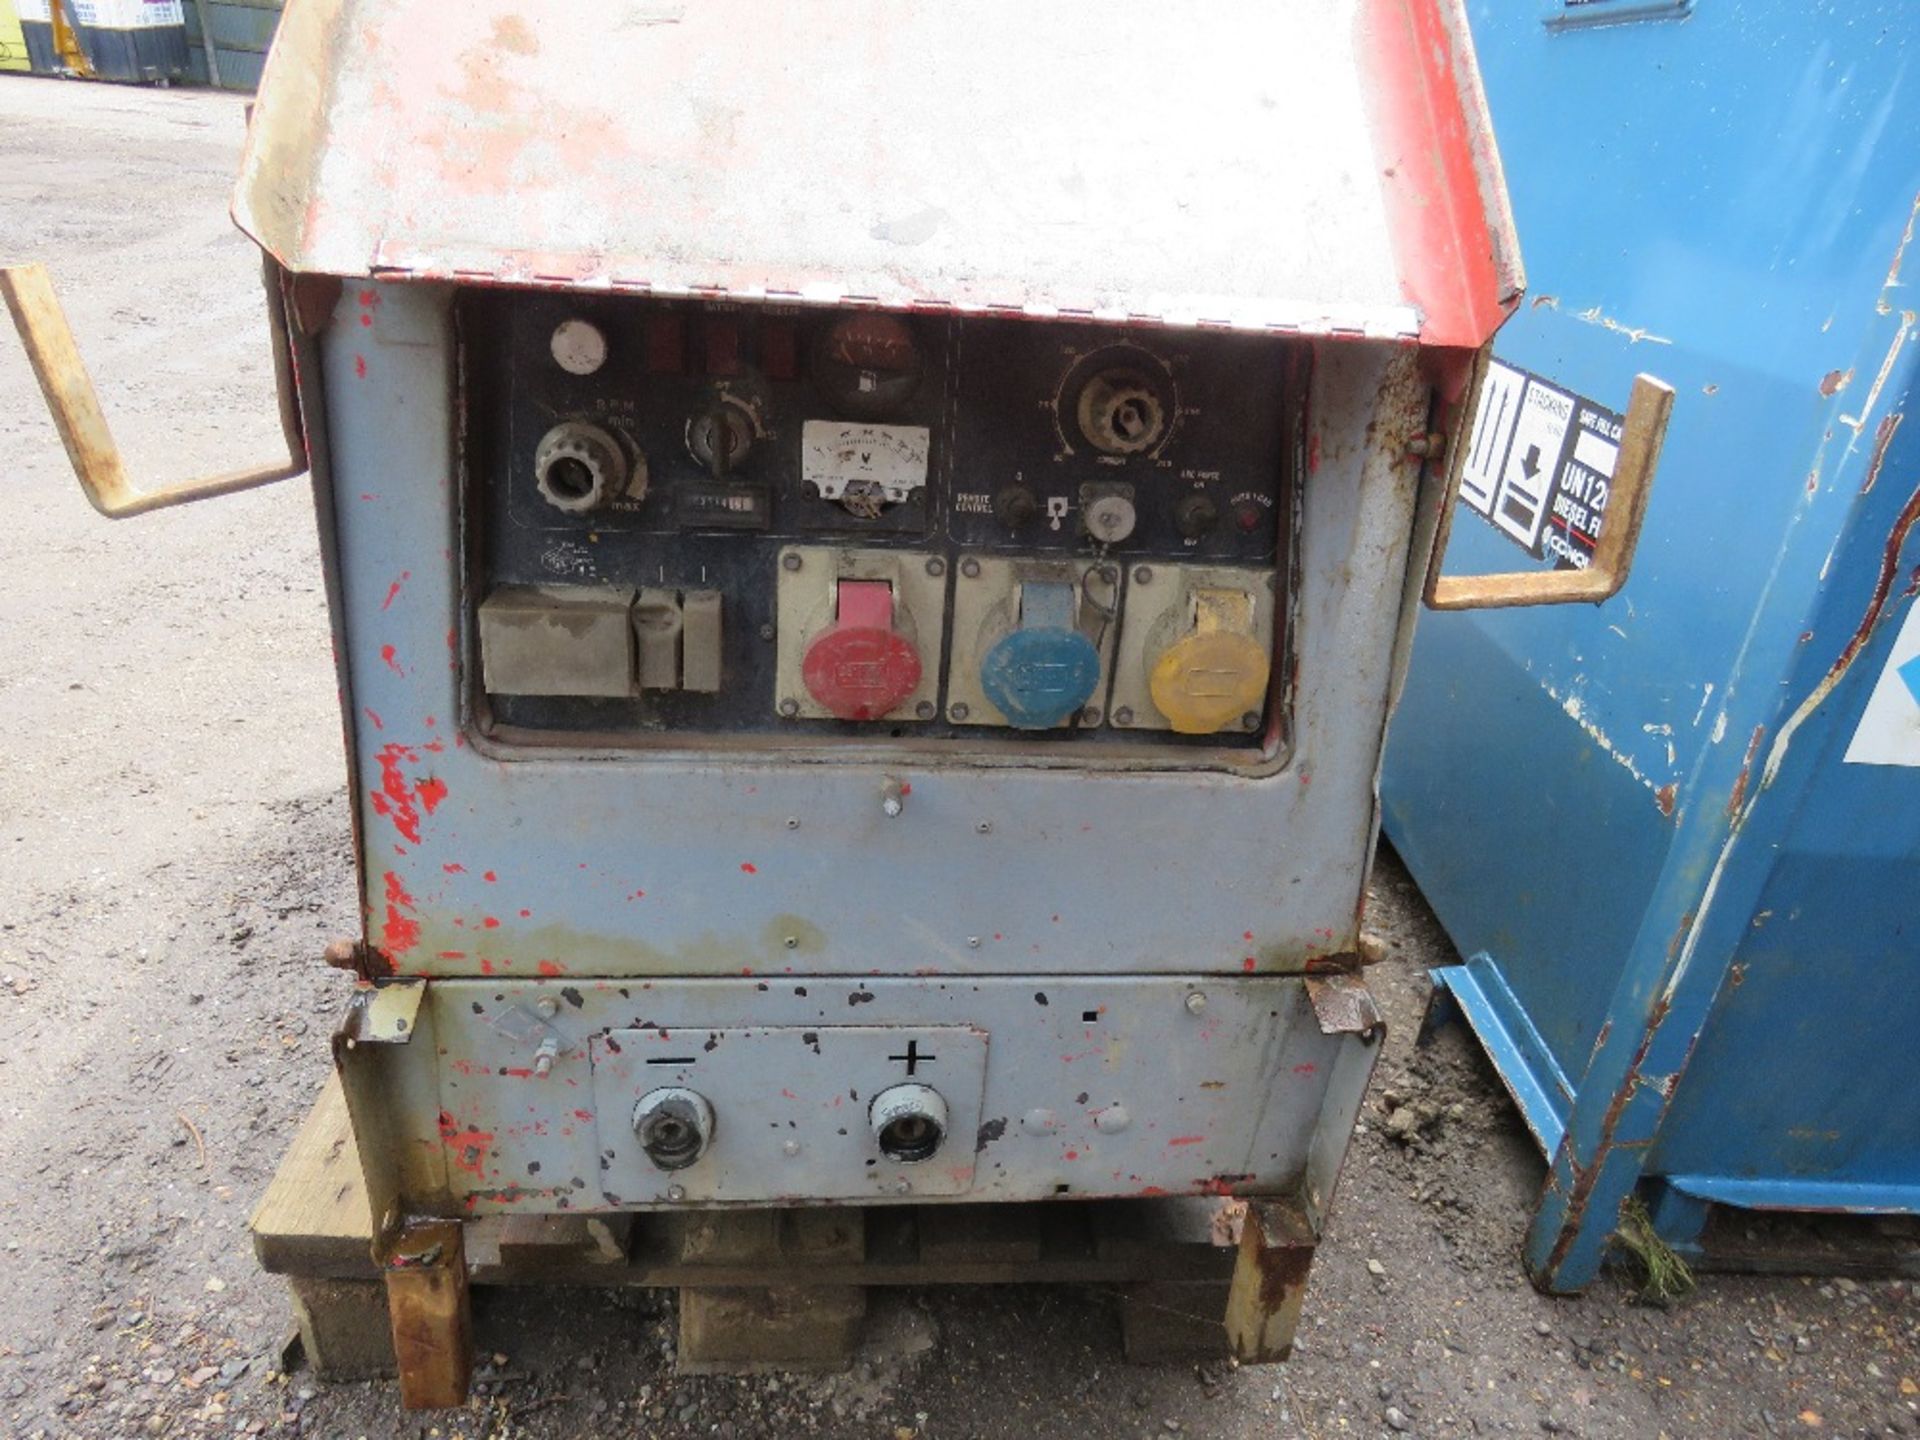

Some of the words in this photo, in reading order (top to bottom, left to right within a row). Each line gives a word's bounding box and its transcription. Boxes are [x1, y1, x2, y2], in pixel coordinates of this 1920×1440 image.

[1560, 461, 1610, 512] UN12
[611, 502, 640, 511] max
[1552, 493, 1588, 530] DIESEL
